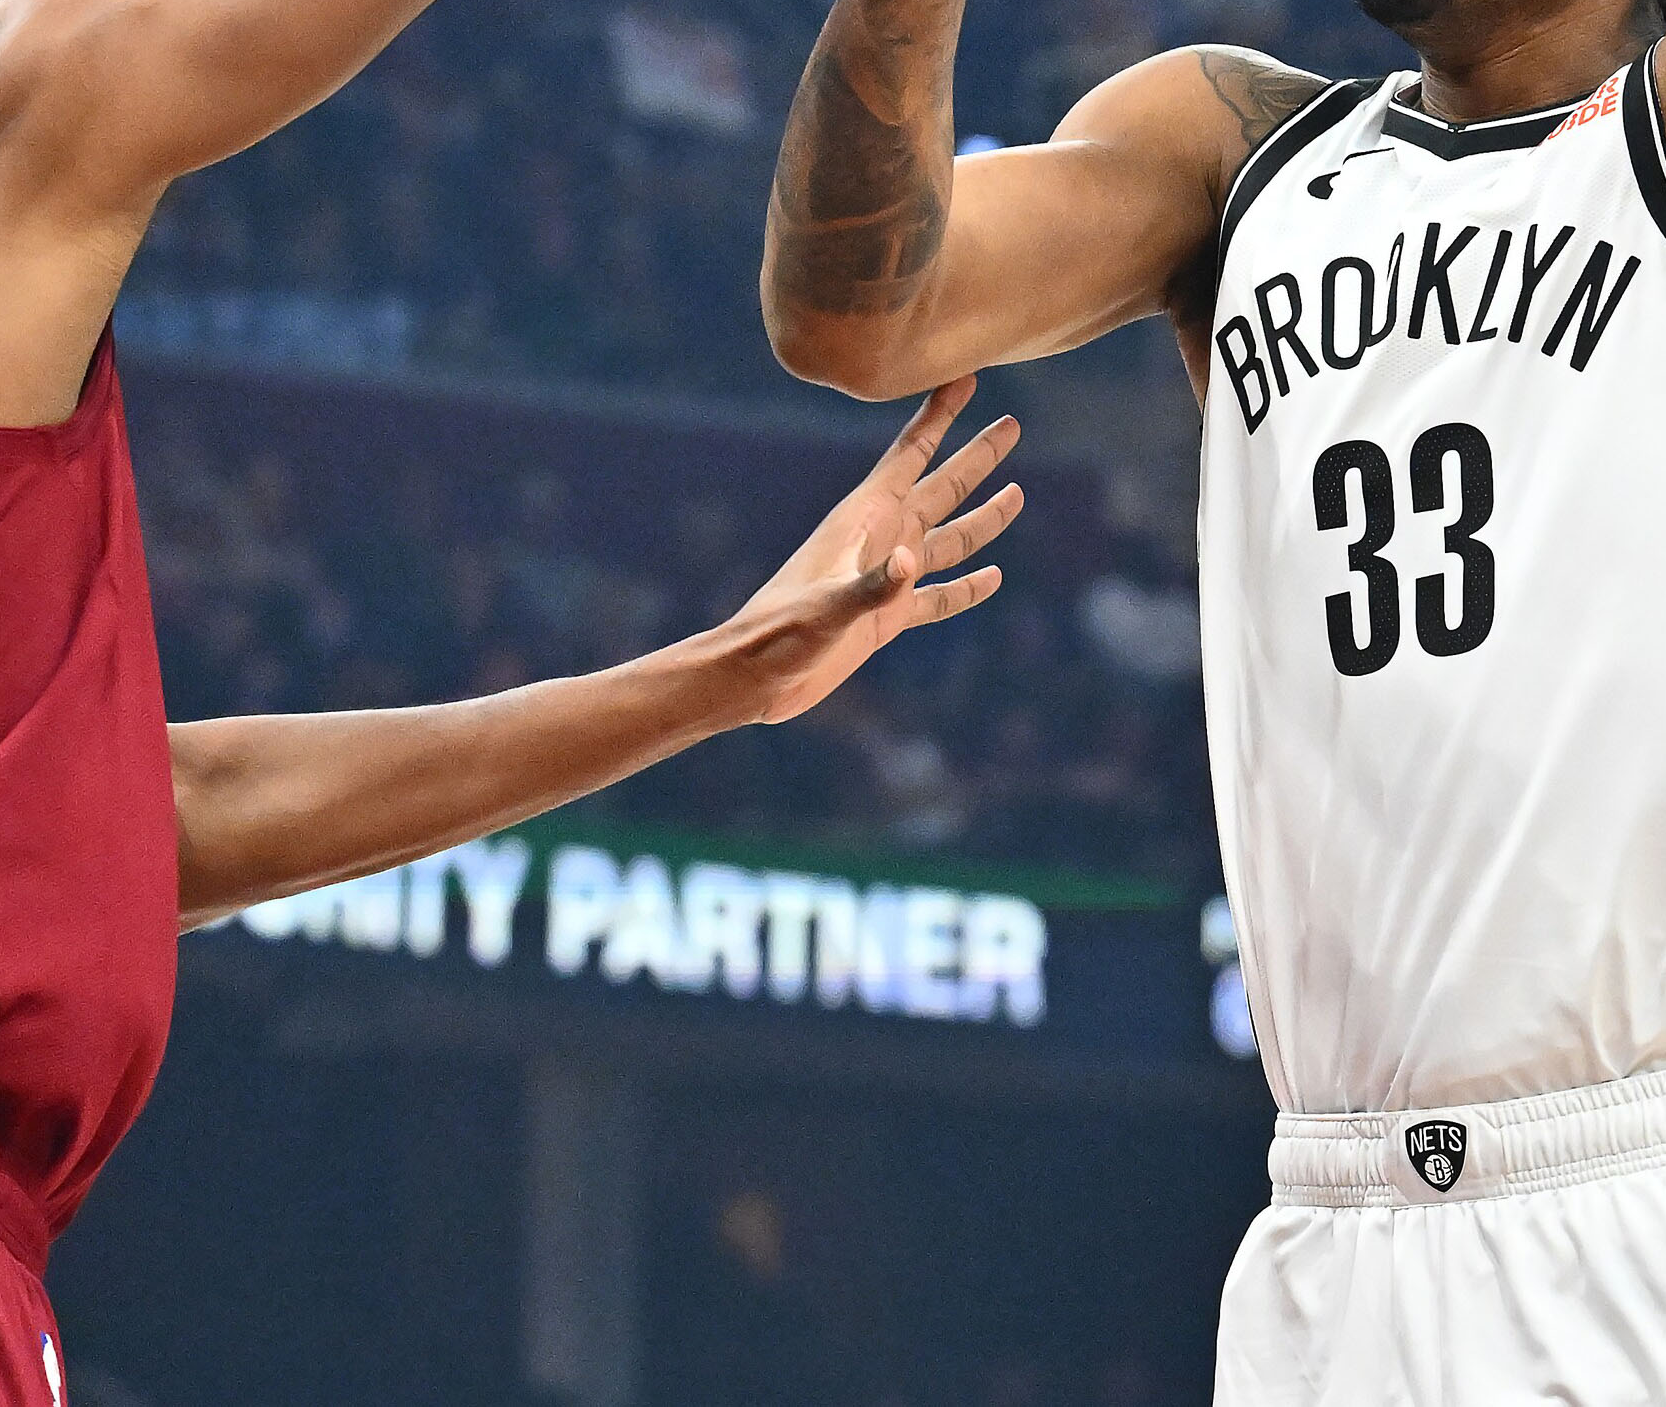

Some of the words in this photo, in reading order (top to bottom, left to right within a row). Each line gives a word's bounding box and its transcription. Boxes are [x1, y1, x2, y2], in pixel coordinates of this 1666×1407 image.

[1215, 222, 1641, 436] BROOKLYN
[1313, 423, 1494, 676] 33
[546, 846, 1046, 1024] PARTNER
[1410, 1125, 1462, 1157] NETS
[1433, 1158, 1445, 1181] B
